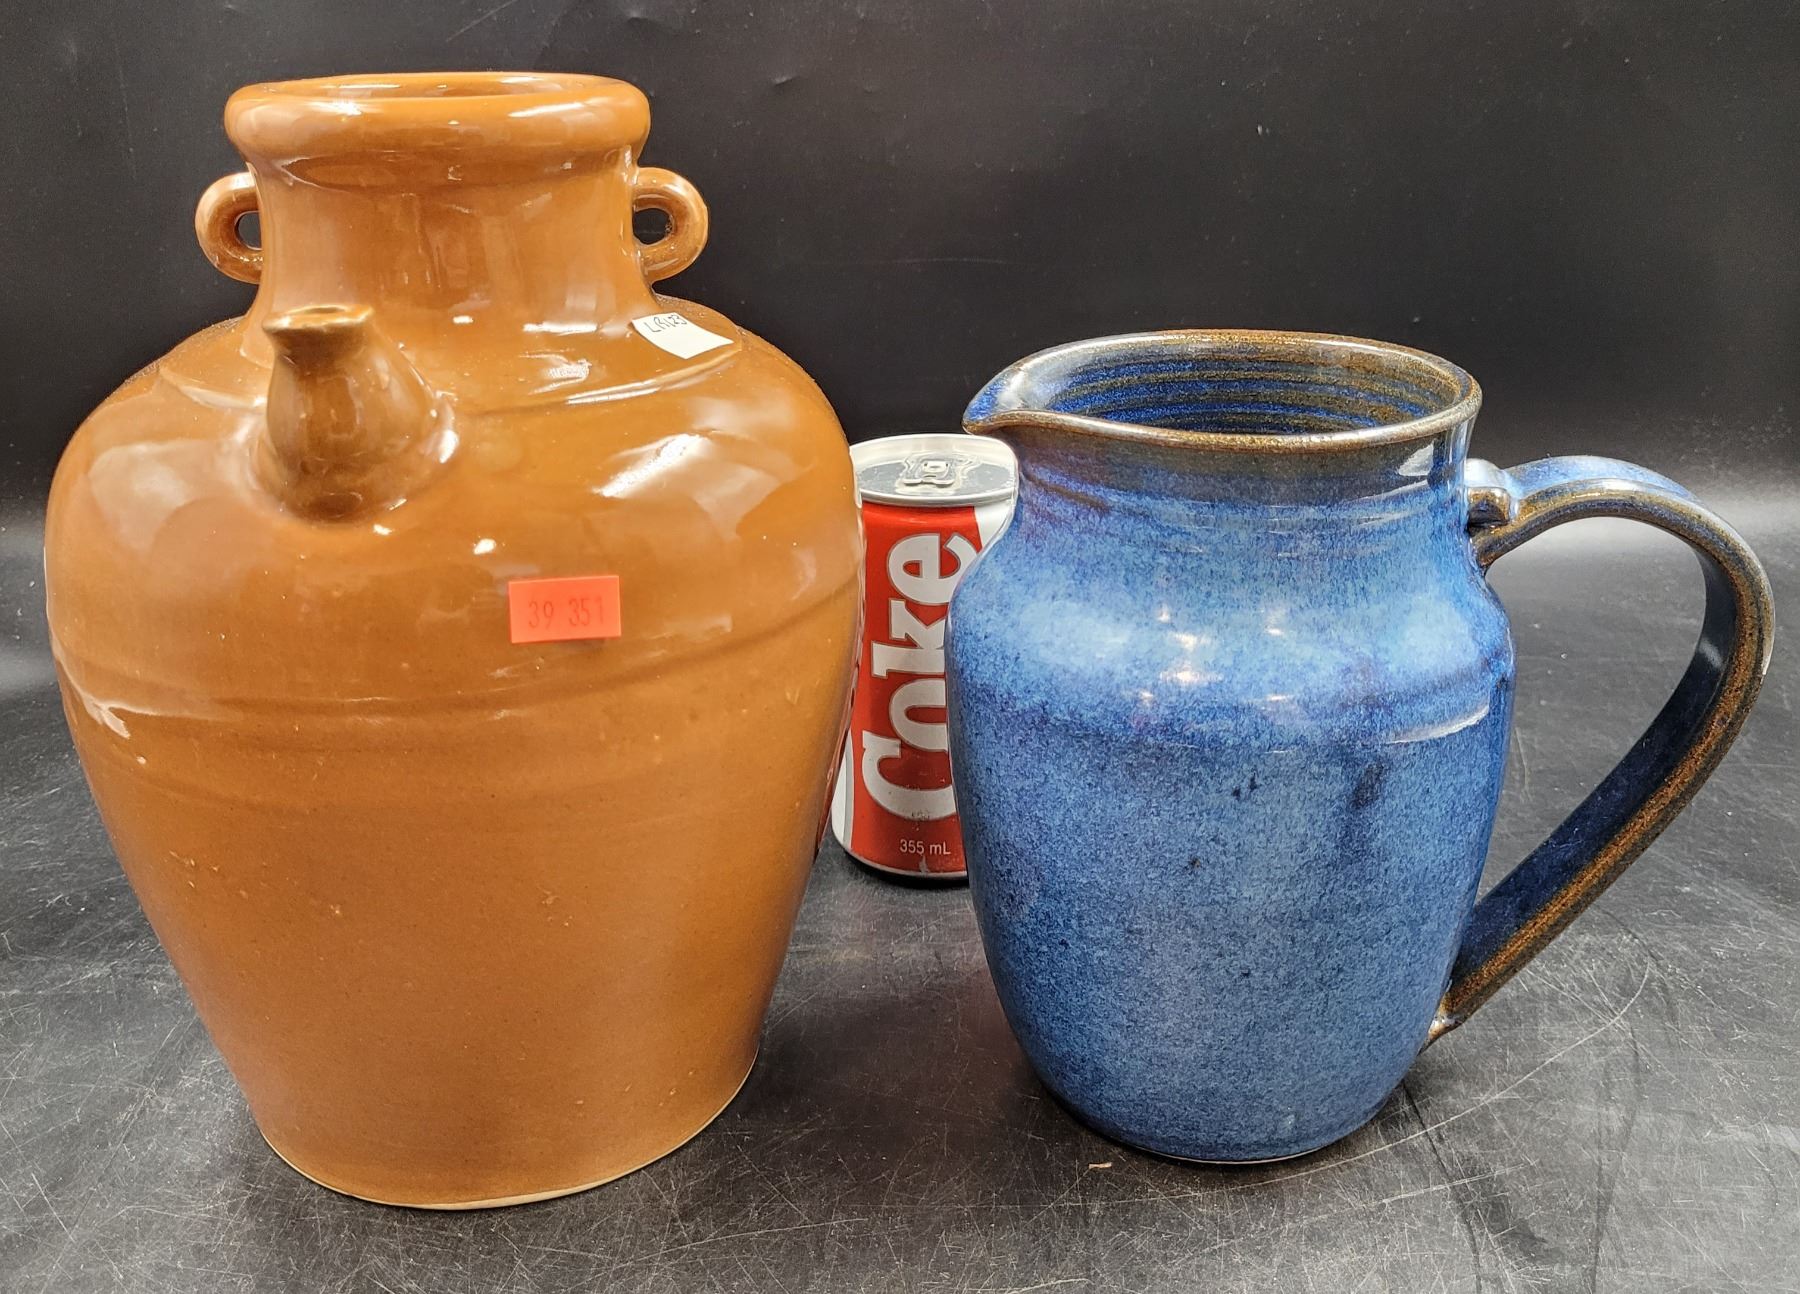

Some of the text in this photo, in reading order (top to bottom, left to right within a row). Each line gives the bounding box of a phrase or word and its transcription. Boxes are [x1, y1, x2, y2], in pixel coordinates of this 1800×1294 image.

[862, 533, 979, 820] Coke
[900, 838, 952, 856] 355 mL
